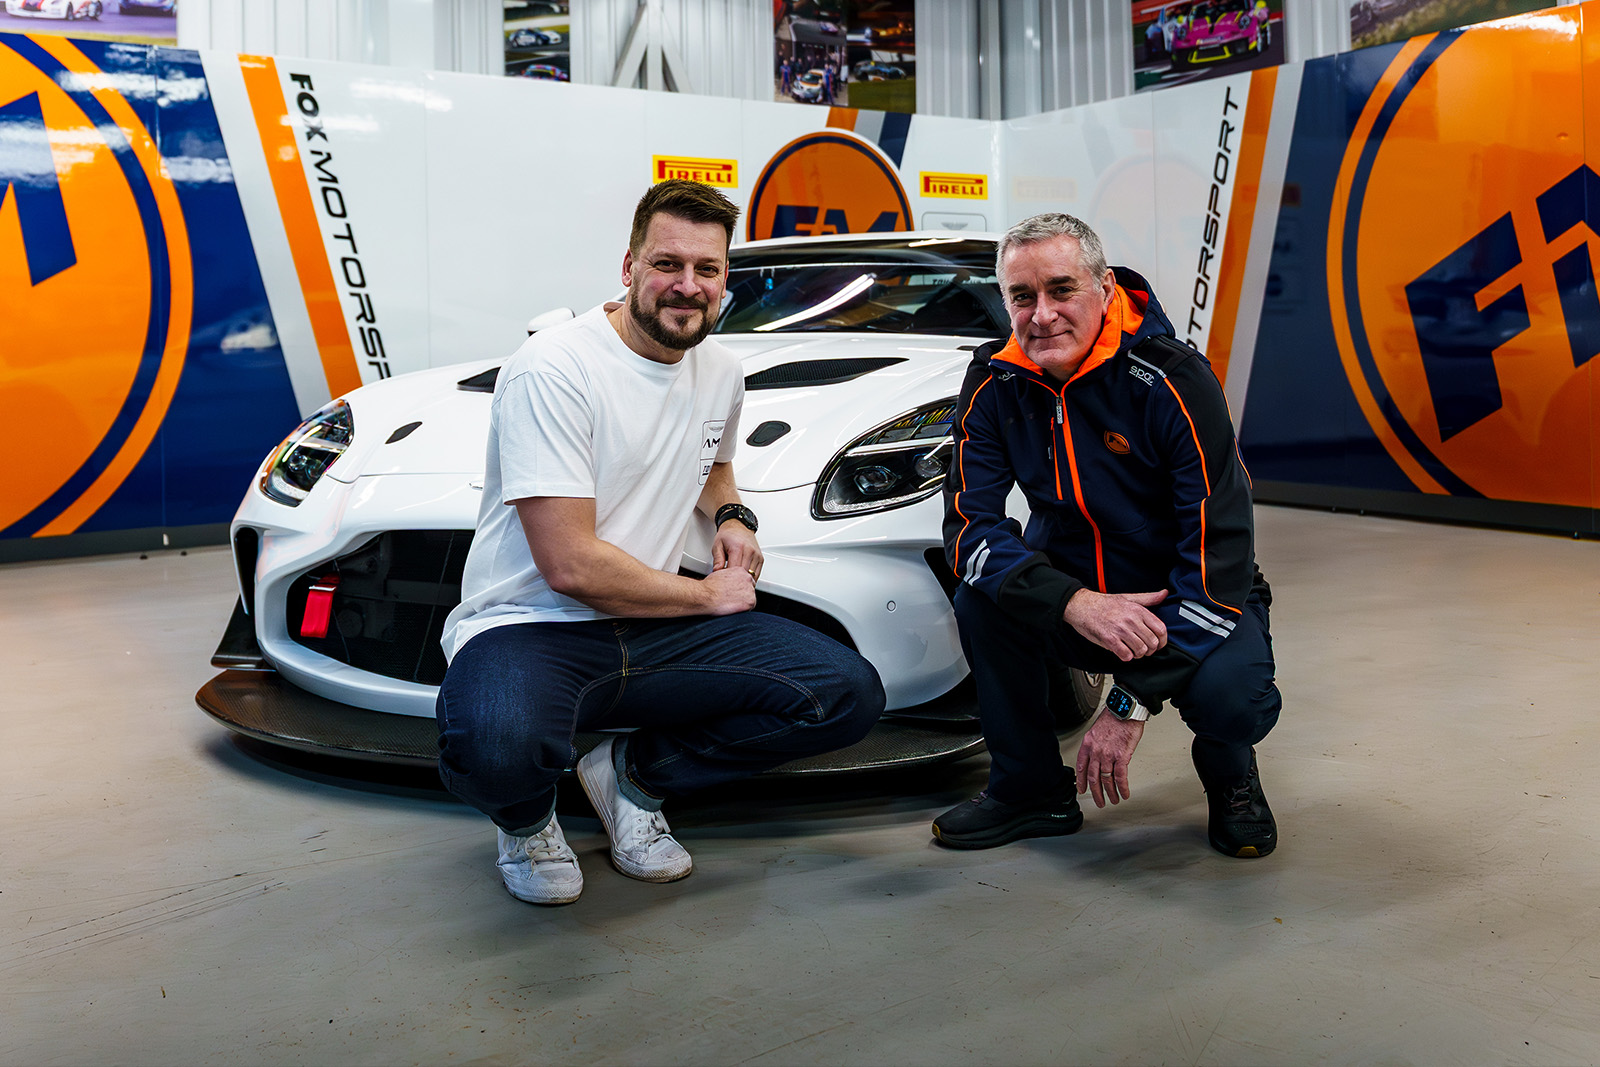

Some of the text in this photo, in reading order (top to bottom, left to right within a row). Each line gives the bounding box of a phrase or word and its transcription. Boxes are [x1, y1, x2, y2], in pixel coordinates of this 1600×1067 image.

[289, 73, 328, 142] FOX
[657, 160, 732, 183] PIRELLI
[924, 176, 983, 195] PIRELLI
[1186, 86, 1238, 351] TORSPORT
